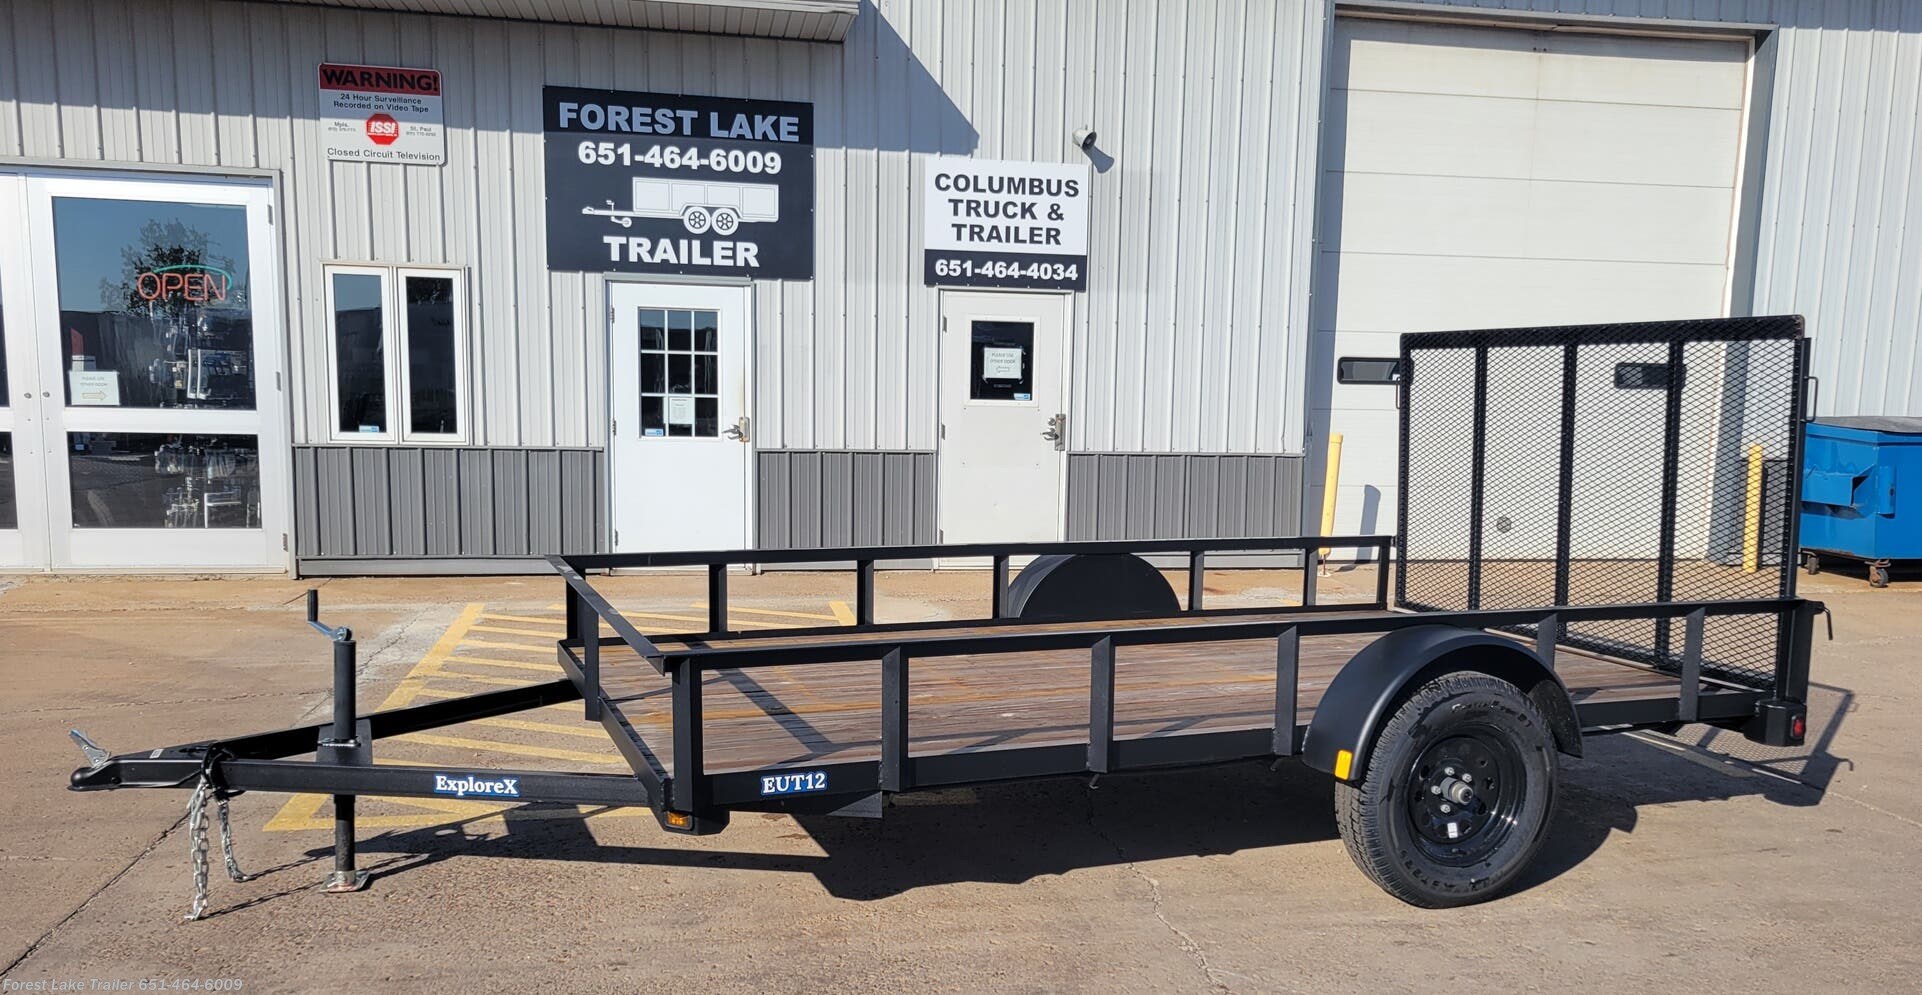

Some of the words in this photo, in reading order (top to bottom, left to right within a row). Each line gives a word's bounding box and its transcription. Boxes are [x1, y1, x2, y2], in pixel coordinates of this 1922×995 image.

[322, 68, 440, 92] WARNING!
[333, 100, 371, 110] Recorded
[386, 104, 409, 112] Video
[411, 105, 429, 113] Tape
[340, 93, 350, 101] 24
[352, 94, 372, 102] Hour
[374, 95, 422, 105] Surveillance
[370, 121, 397, 134] ISSI
[558, 101, 698, 136] FOREST
[710, 111, 799, 142] LAKE
[327, 147, 360, 157] Closed
[363, 149, 393, 159] Circuit
[397, 151, 440, 161] Television
[578, 141, 782, 175] 651-464-6009
[935, 173, 1080, 198] COLUMBUS
[948, 198, 1038, 220] TRUCK
[1047, 203, 1065, 221] &
[951, 223, 1062, 246] TRAILER
[603, 235, 760, 268] TRAILER
[935, 259, 1078, 281] 651-464-4034
[137, 271, 226, 301] OPEN
[435, 775, 518, 796] ExploreX
[762, 773, 826, 793] EUT12
